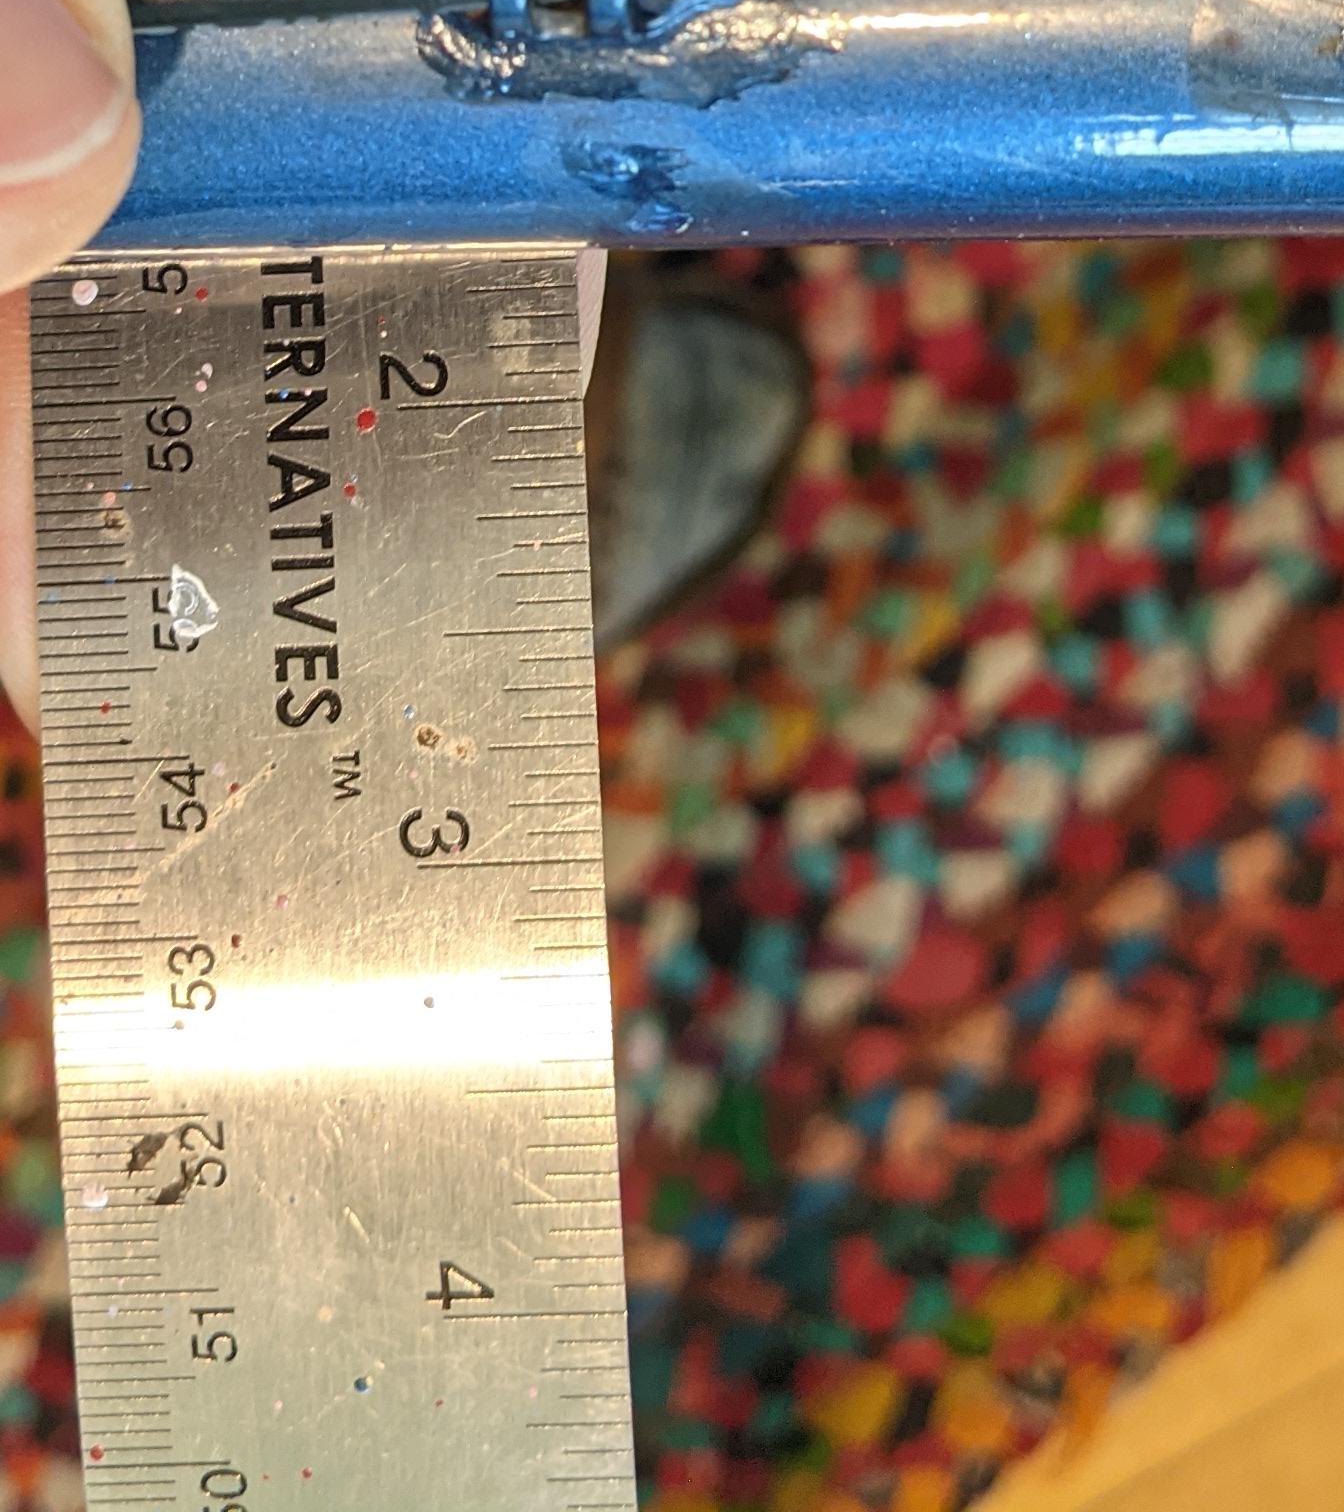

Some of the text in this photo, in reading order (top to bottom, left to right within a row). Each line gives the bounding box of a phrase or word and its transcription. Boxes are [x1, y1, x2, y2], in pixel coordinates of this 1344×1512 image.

[142, 263, 188, 294] 5
[379, 350, 449, 399] 2
[146, 403, 194, 473] 56
[260, 256, 361, 800] TERNATIVES TM
[161, 763, 208, 833] 54
[399, 809, 470, 858] 3
[168, 943, 216, 1011] 53
[180, 1120, 227, 1189] 52
[426, 1261, 494, 1310] 4
[190, 1307, 238, 1364] 51
